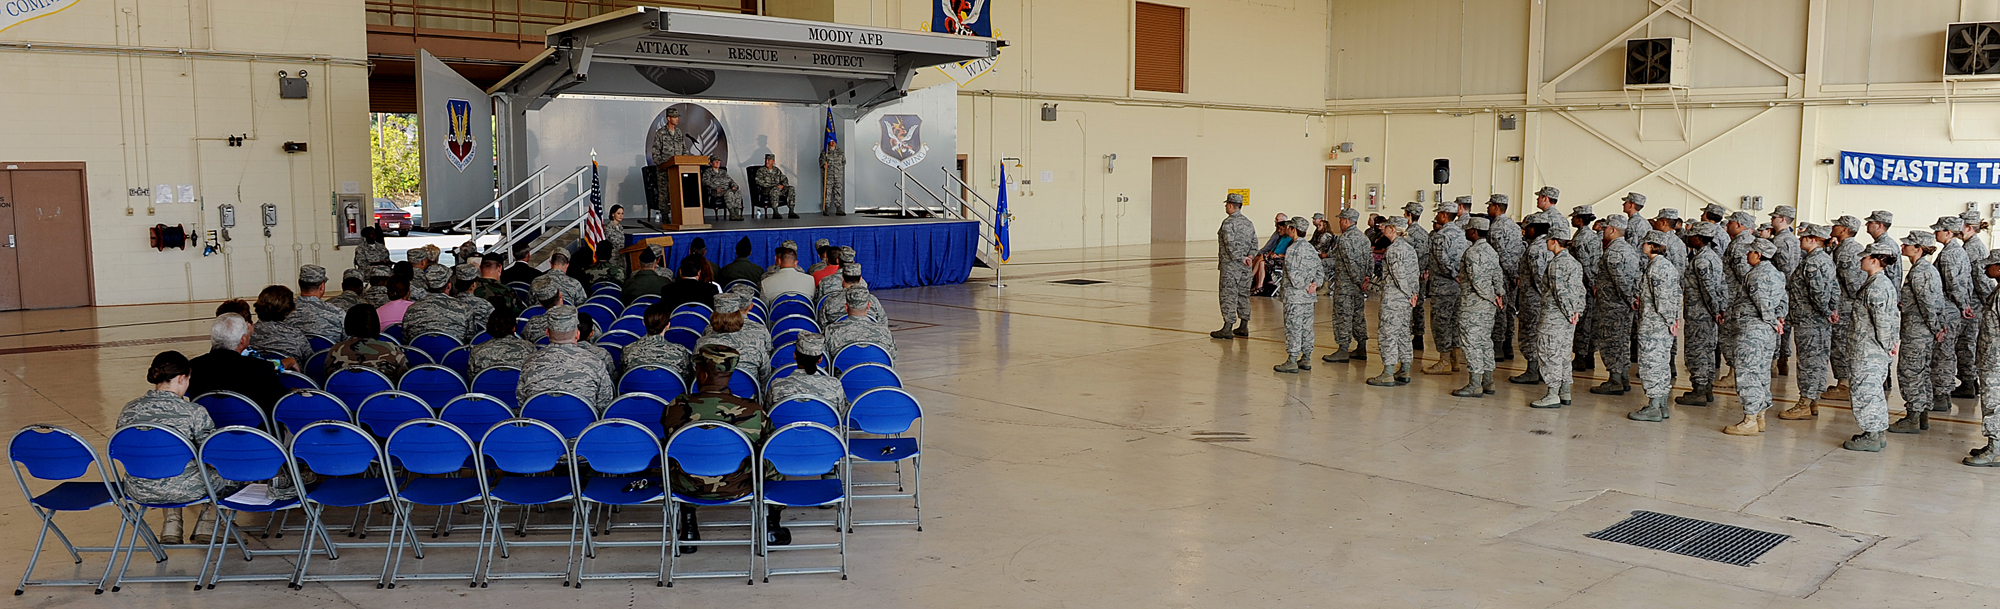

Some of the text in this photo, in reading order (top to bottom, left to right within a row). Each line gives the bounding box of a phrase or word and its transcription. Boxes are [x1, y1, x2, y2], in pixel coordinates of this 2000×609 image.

[808, 28, 883, 46] MOODY AFB
[635, 41, 865, 67] ATTACK RESCUE PROTECT
[903, 151, 925, 167] WING
[1844, 156, 1875, 180] NO
[1882, 158, 1969, 184] FASTER
